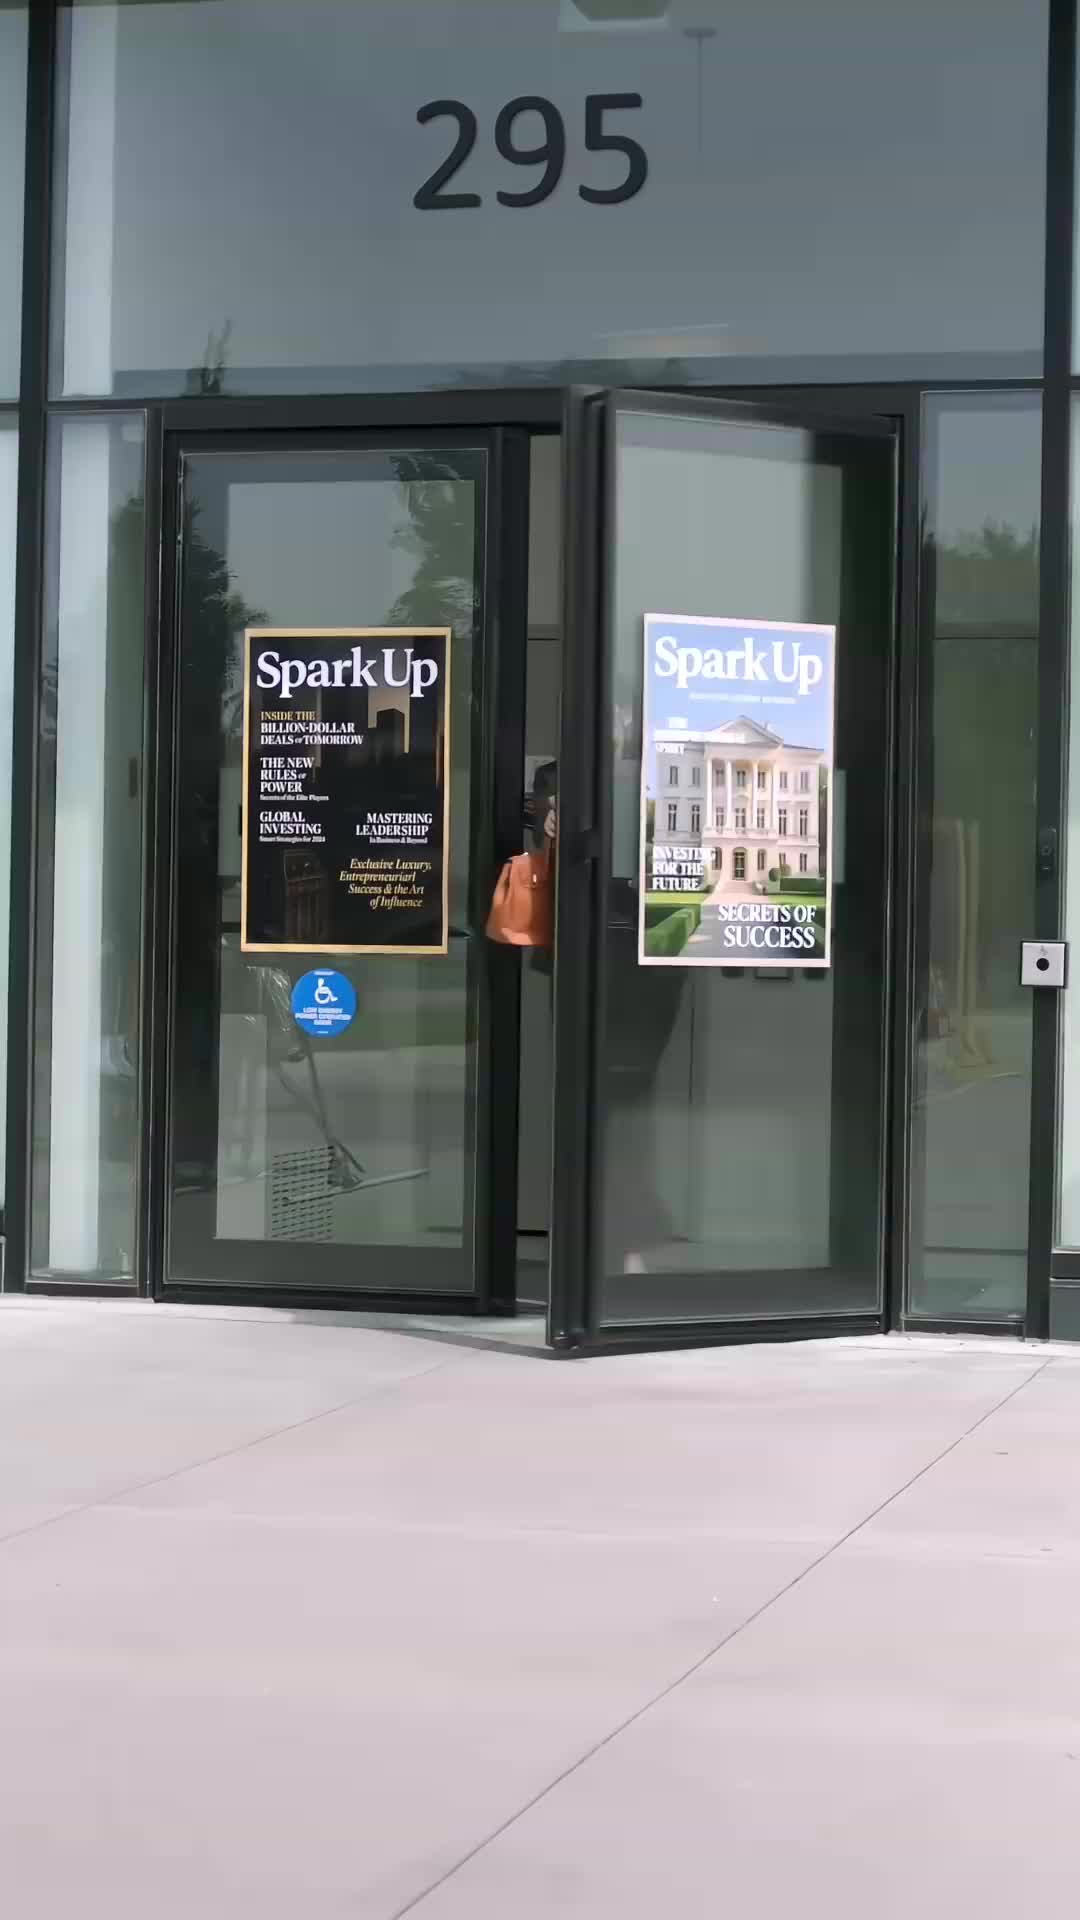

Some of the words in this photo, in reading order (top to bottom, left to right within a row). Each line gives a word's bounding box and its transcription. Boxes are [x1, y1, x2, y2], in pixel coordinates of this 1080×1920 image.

[413, 92, 648, 210] 295
[655, 636, 768, 689] Spark
[772, 641, 823, 695] Up
[256, 646, 378, 698] Spark
[381, 648, 438, 698] Up
[261, 711, 293, 721] INSIDE
[295, 711, 315, 721] THE
[260, 722, 355, 733] BILLION-DOLLAR
[260, 735, 294, 745] DEALS
[303, 735, 364, 745] TOMORROW
[260, 757, 285, 769] THE
[287, 757, 315, 769] NEW
[260, 769, 297, 780] RULES
[260, 781, 302, 793] POWER
[260, 811, 306, 823] GLOBAL
[366, 813, 432, 824] MASTERING
[260, 823, 321, 835] INVESTING
[356, 824, 429, 836] LEADERSHIP
[350, 858, 394, 869] Exclusive
[652, 861, 678, 875] FOR
[680, 862, 704, 876] THE
[348, 883, 382, 894] Success
[383, 883, 392, 894] &
[394, 883, 408, 895] the
[408, 884, 425, 895] Art
[652, 877, 701, 891] FUTURE
[370, 895, 381, 910] of
[380, 895, 423, 910] Influence
[717, 903, 790, 922] SECRETS
[793, 904, 817, 923] OF
[723, 925, 815, 948] SUCCESS
